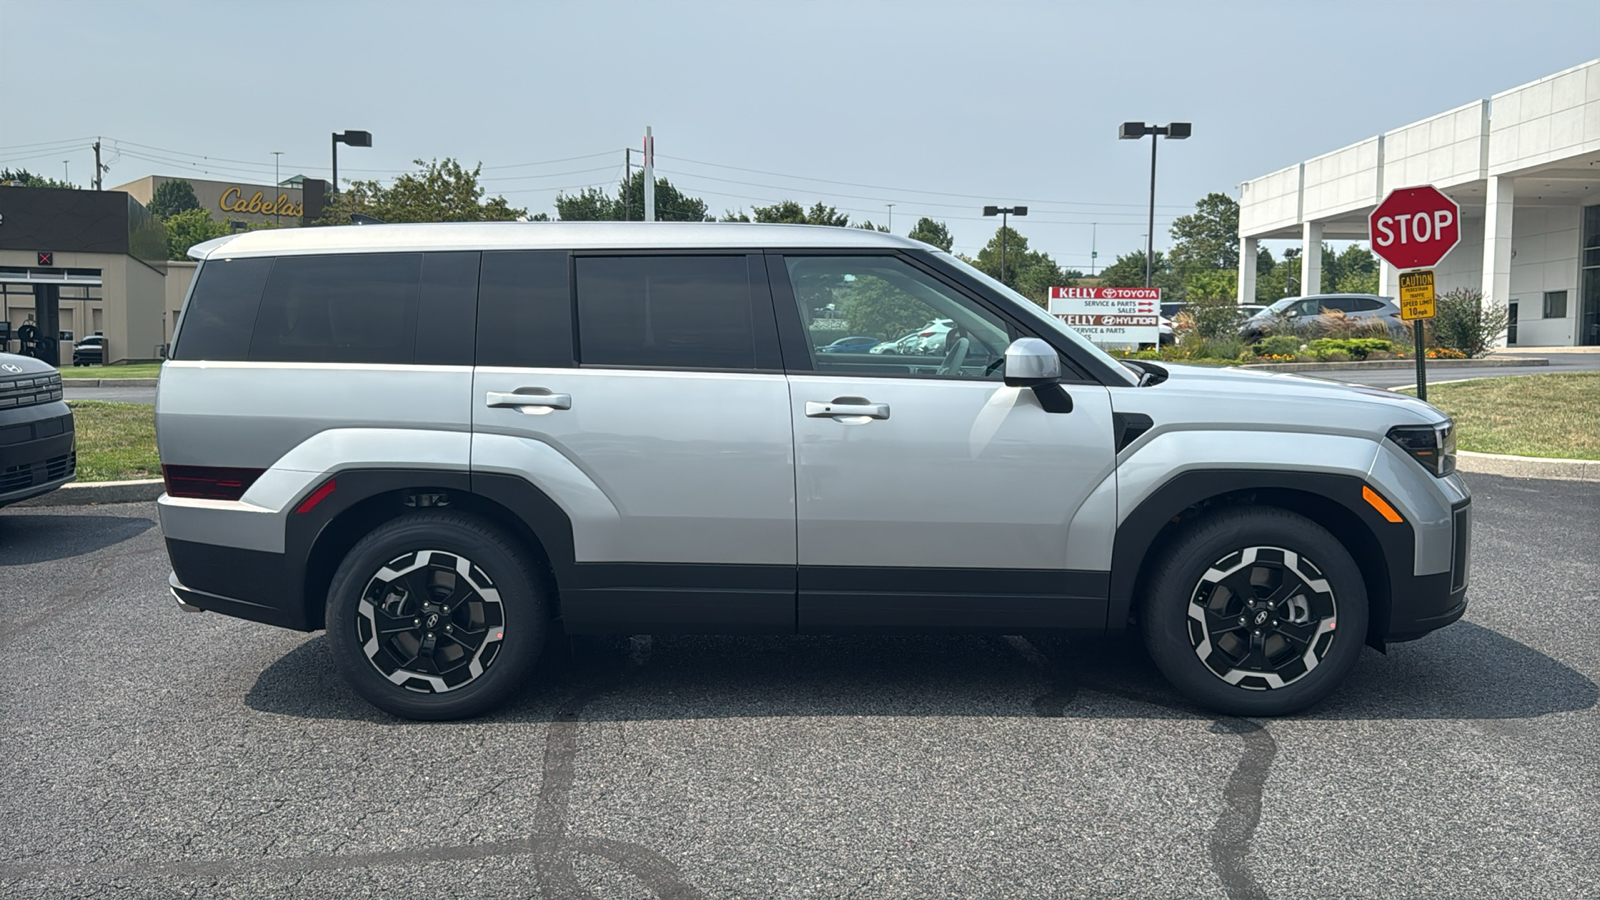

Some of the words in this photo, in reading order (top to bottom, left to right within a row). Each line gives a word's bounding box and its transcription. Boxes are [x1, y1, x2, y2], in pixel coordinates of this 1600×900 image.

[219, 186, 303, 217] Cabela's
[1376, 209, 1453, 247] STOP
[1400, 274, 1433, 287] CAUTION
[1059, 287, 1097, 298] KELLY
[1117, 289, 1157, 298] TOYOTA
[1402, 300, 1418, 308] SPEED
[1116, 317, 1156, 325] HYUNDAI
